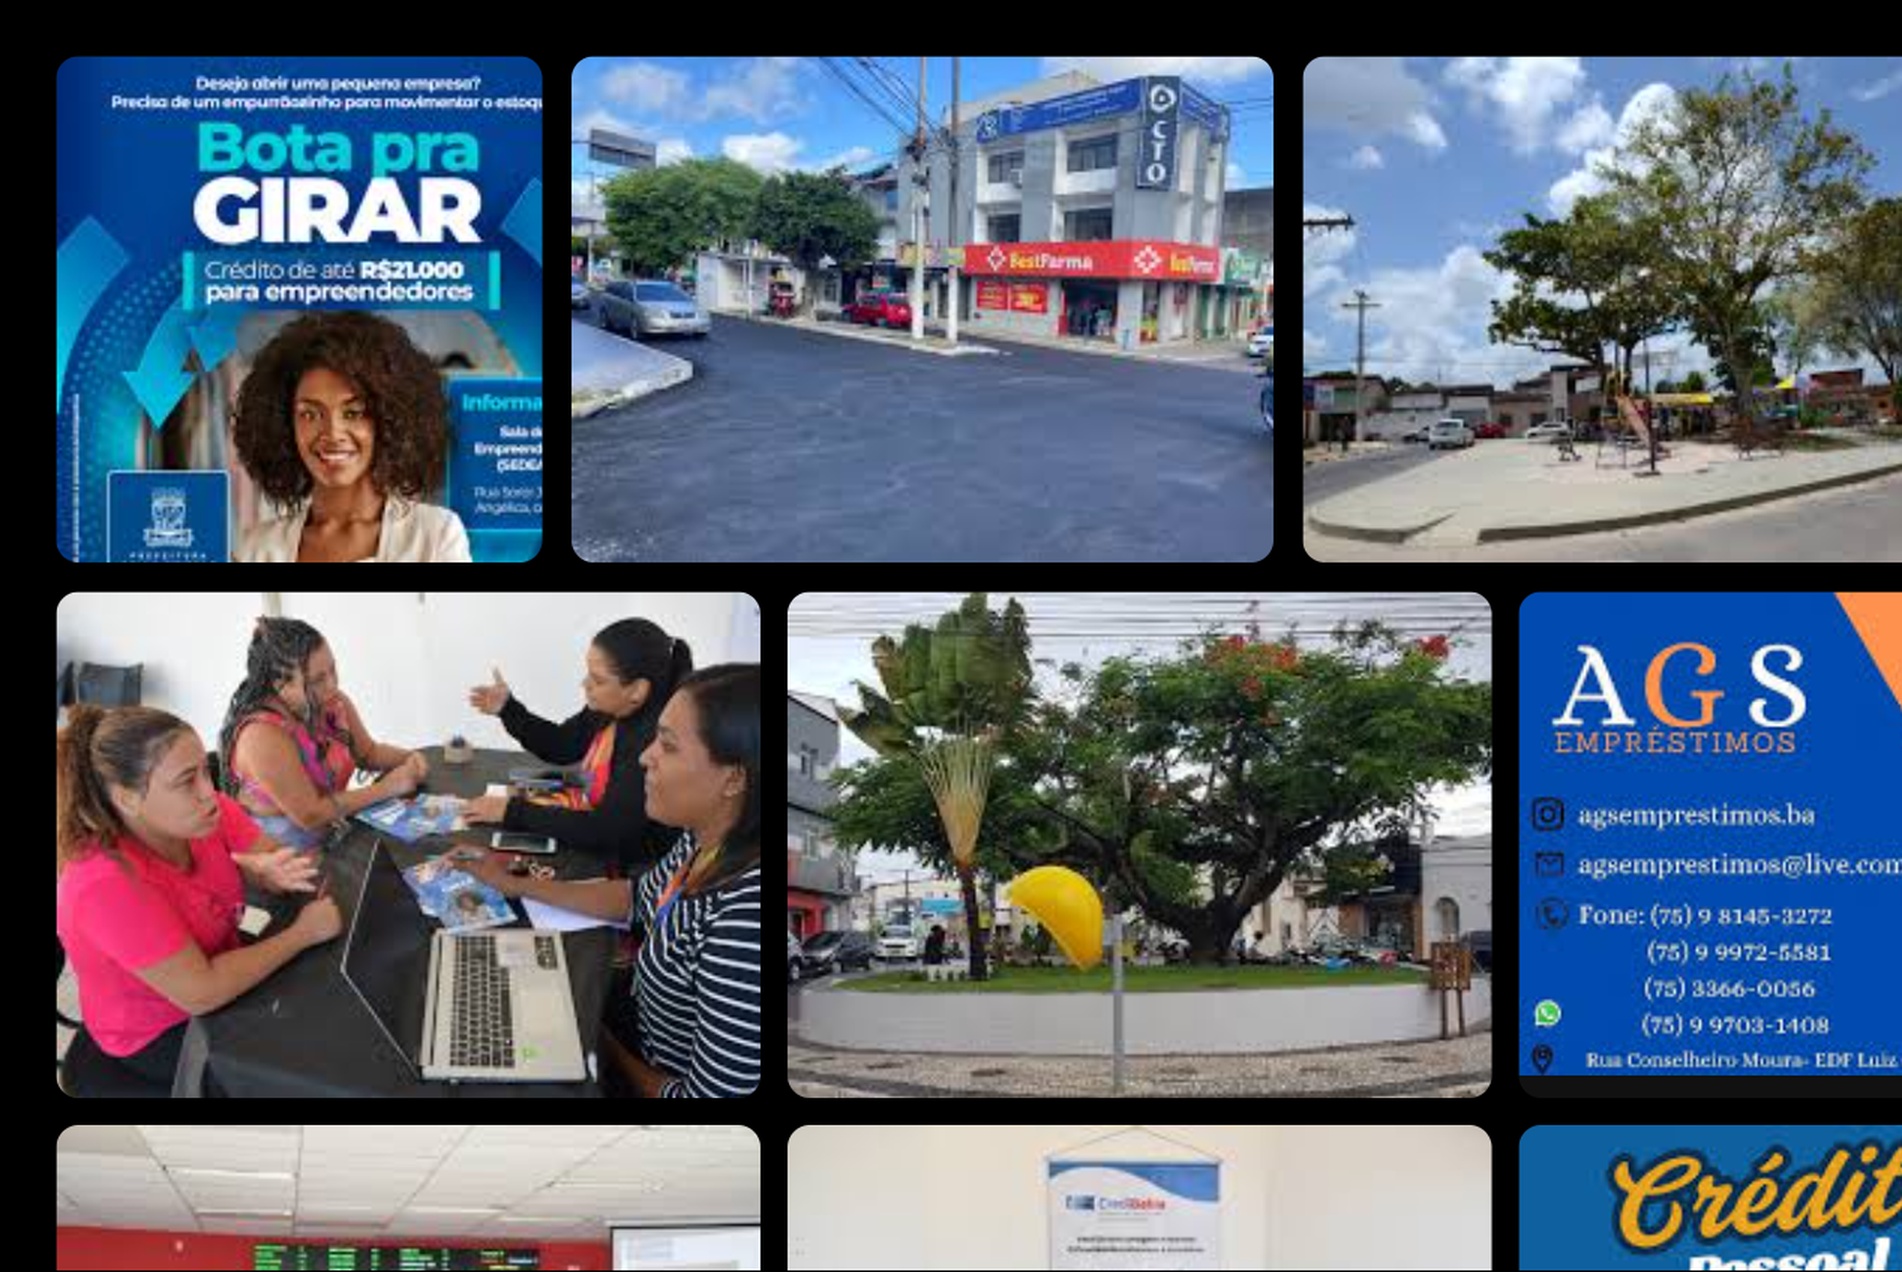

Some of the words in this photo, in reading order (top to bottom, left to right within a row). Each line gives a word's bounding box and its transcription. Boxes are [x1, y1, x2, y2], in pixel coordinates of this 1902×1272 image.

[196, 76, 249, 93] Deseja
[251, 76, 288, 91] abrir
[291, 78, 329, 91] uma
[331, 78, 401, 93] pequena
[403, 76, 481, 93] empresa?
[111, 94, 168, 109] Precisa
[170, 94, 191, 109] de
[193, 96, 220, 109] um
[345, 97, 383, 111] para
[384, 95, 480, 109] movimentar
[482, 98, 493, 109] o
[199, 121, 352, 171] Bota
[372, 132, 480, 178] pra
[192, 177, 482, 244] GIRAR
[205, 259, 284, 279] Crédito
[288, 260, 316, 279] de
[320, 260, 355, 279] até
[359, 260, 464, 283] R$21.000
[205, 283, 260, 304] para
[265, 281, 473, 304] empreendedores
[499, 425, 529, 438] Sala
[1555, 725, 1797, 754] EMPRÉSTIMOS
[1578, 802, 1816, 829] agsemprestimos.ba
[1579, 903, 1645, 926] Fone:
[1650, 902, 1693, 929] (75)
[1698, 908, 1712, 926] 9
[1718, 907, 1833, 926] 8145-3272
[1647, 939, 1690, 966] (75)
[1695, 944, 1709, 962] 9
[1714, 943, 1832, 963] 9972-5581
[1643, 975, 1687, 1001] (75)
[1691, 979, 1816, 999] 3366-0056
[1641, 1012, 1684, 1038] (75)
[1689, 1017, 1704, 1036] 9
[1708, 1016, 1830, 1036] 9703-1408
[1586, 1051, 1623, 1069] Rua
[1627, 1050, 1737, 1069] Conselheiro
[1815, 1051, 1853, 1069] EDF
[1857, 1051, 1899, 1069] Luiz
